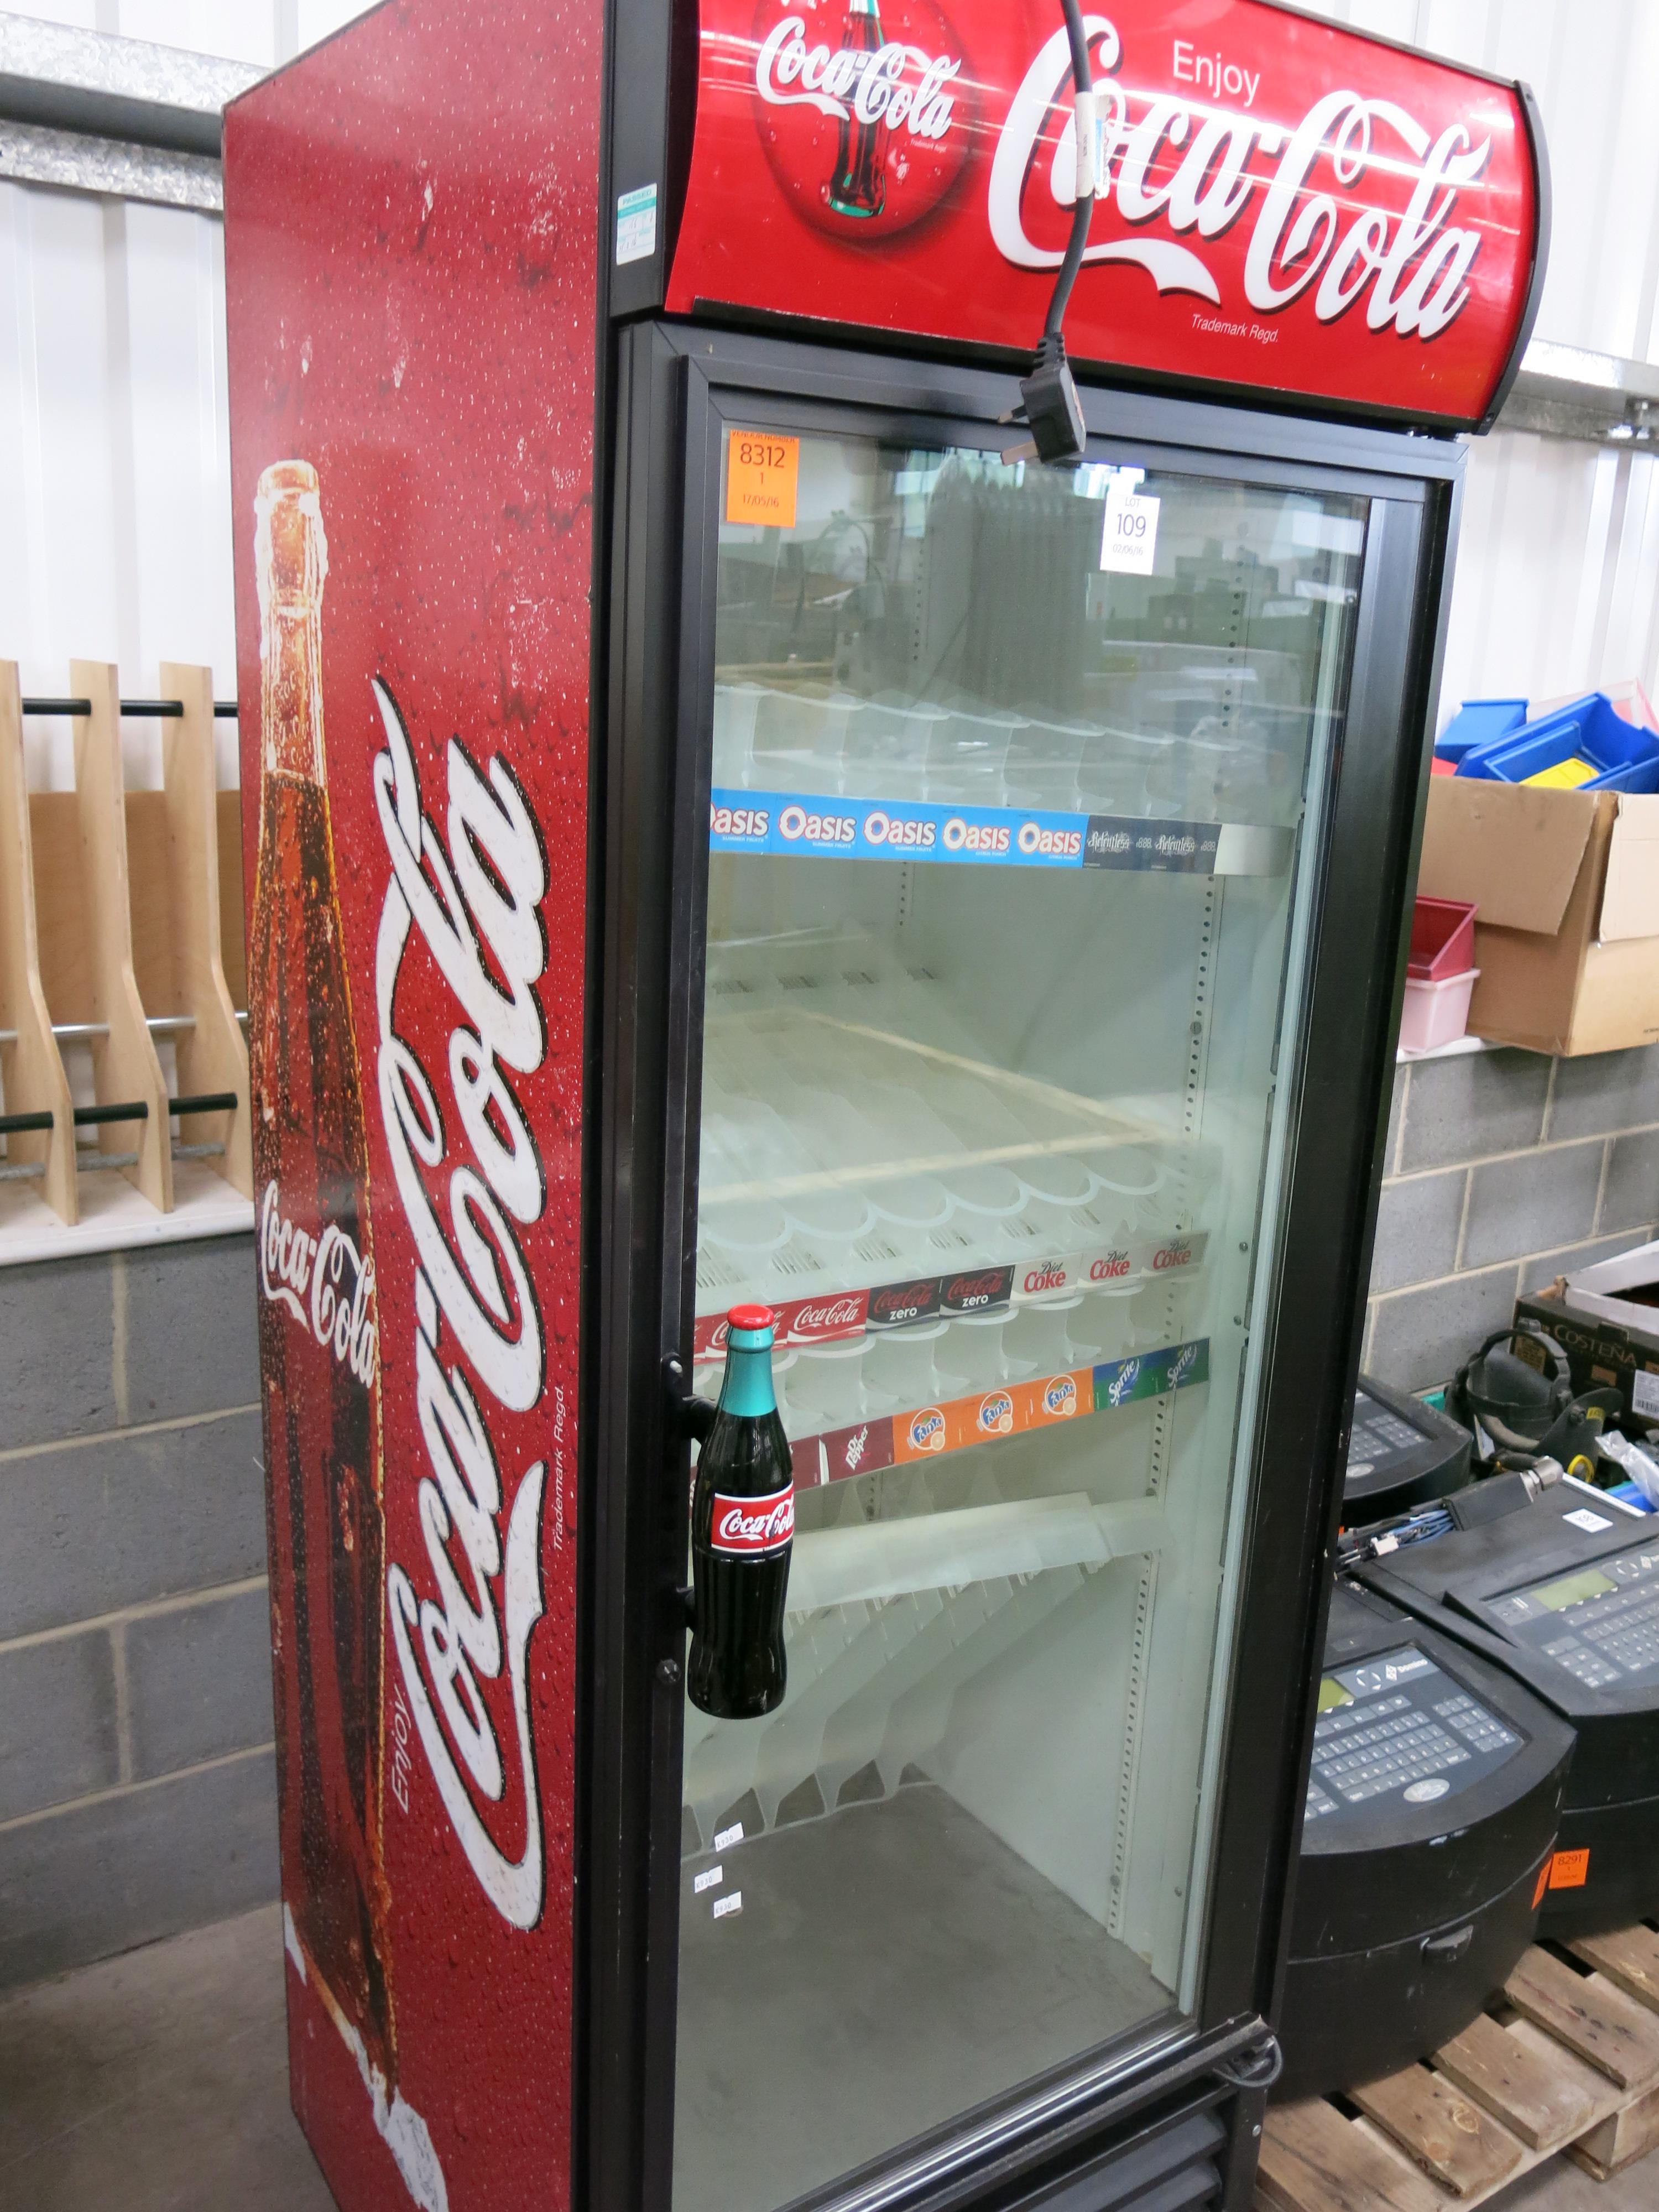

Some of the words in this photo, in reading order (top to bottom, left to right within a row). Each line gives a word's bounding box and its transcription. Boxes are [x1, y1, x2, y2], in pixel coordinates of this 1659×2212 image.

[756, 15, 962, 139] Coca-Cola
[1173, 39, 1261, 107] Enjoy
[1192, 314, 1248, 337] Trademark
[1249, 324, 1279, 345] Regd.
[740, 443, 785, 468] 8312
[760, 472, 764, 484] 1
[743, 493, 779, 508] 17/05/16
[1125, 497, 1142, 507] LOT
[1117, 513, 1146, 538] 109
[710, 801, 770, 837] asis
[778, 805, 857, 842] Oasis
[863, 811, 937, 847] Oasis
[942, 817, 1011, 851] Oasis
[1018, 822, 1081, 854] Oasis
[1041, 1260, 1064, 1275] Diet
[1107, 1250, 1128, 1262] Diet
[1153, 1249, 1192, 1270] Coke
[261, 1178, 375, 1389] Coca-Cola
[1024, 1270, 1067, 1293] Coke
[1089, 1259, 1130, 1281] Coke
[794, 1297, 864, 1331] Coca-Cola
[889, 1307, 917, 1321] zero
[962, 1294, 989, 1308] zero
[1167, 1345, 1193, 1391] Sprite
[1047, 1383, 1073, 1410] Fanta
[1108, 1360, 1135, 1406] Sprite
[982, 1399, 1010, 1426] Fanta
[848, 1434, 858, 1453] Dr
[913, 1417, 942, 1444] Fanta
[846, 1425, 868, 1470] Pepper
[554, 1447, 564, 1551] Trademark
[719, 1494, 794, 1541] Coca-Col
[392, 1683, 411, 1815] Enjoy
[1558, 1854, 1582, 1866] 8291
